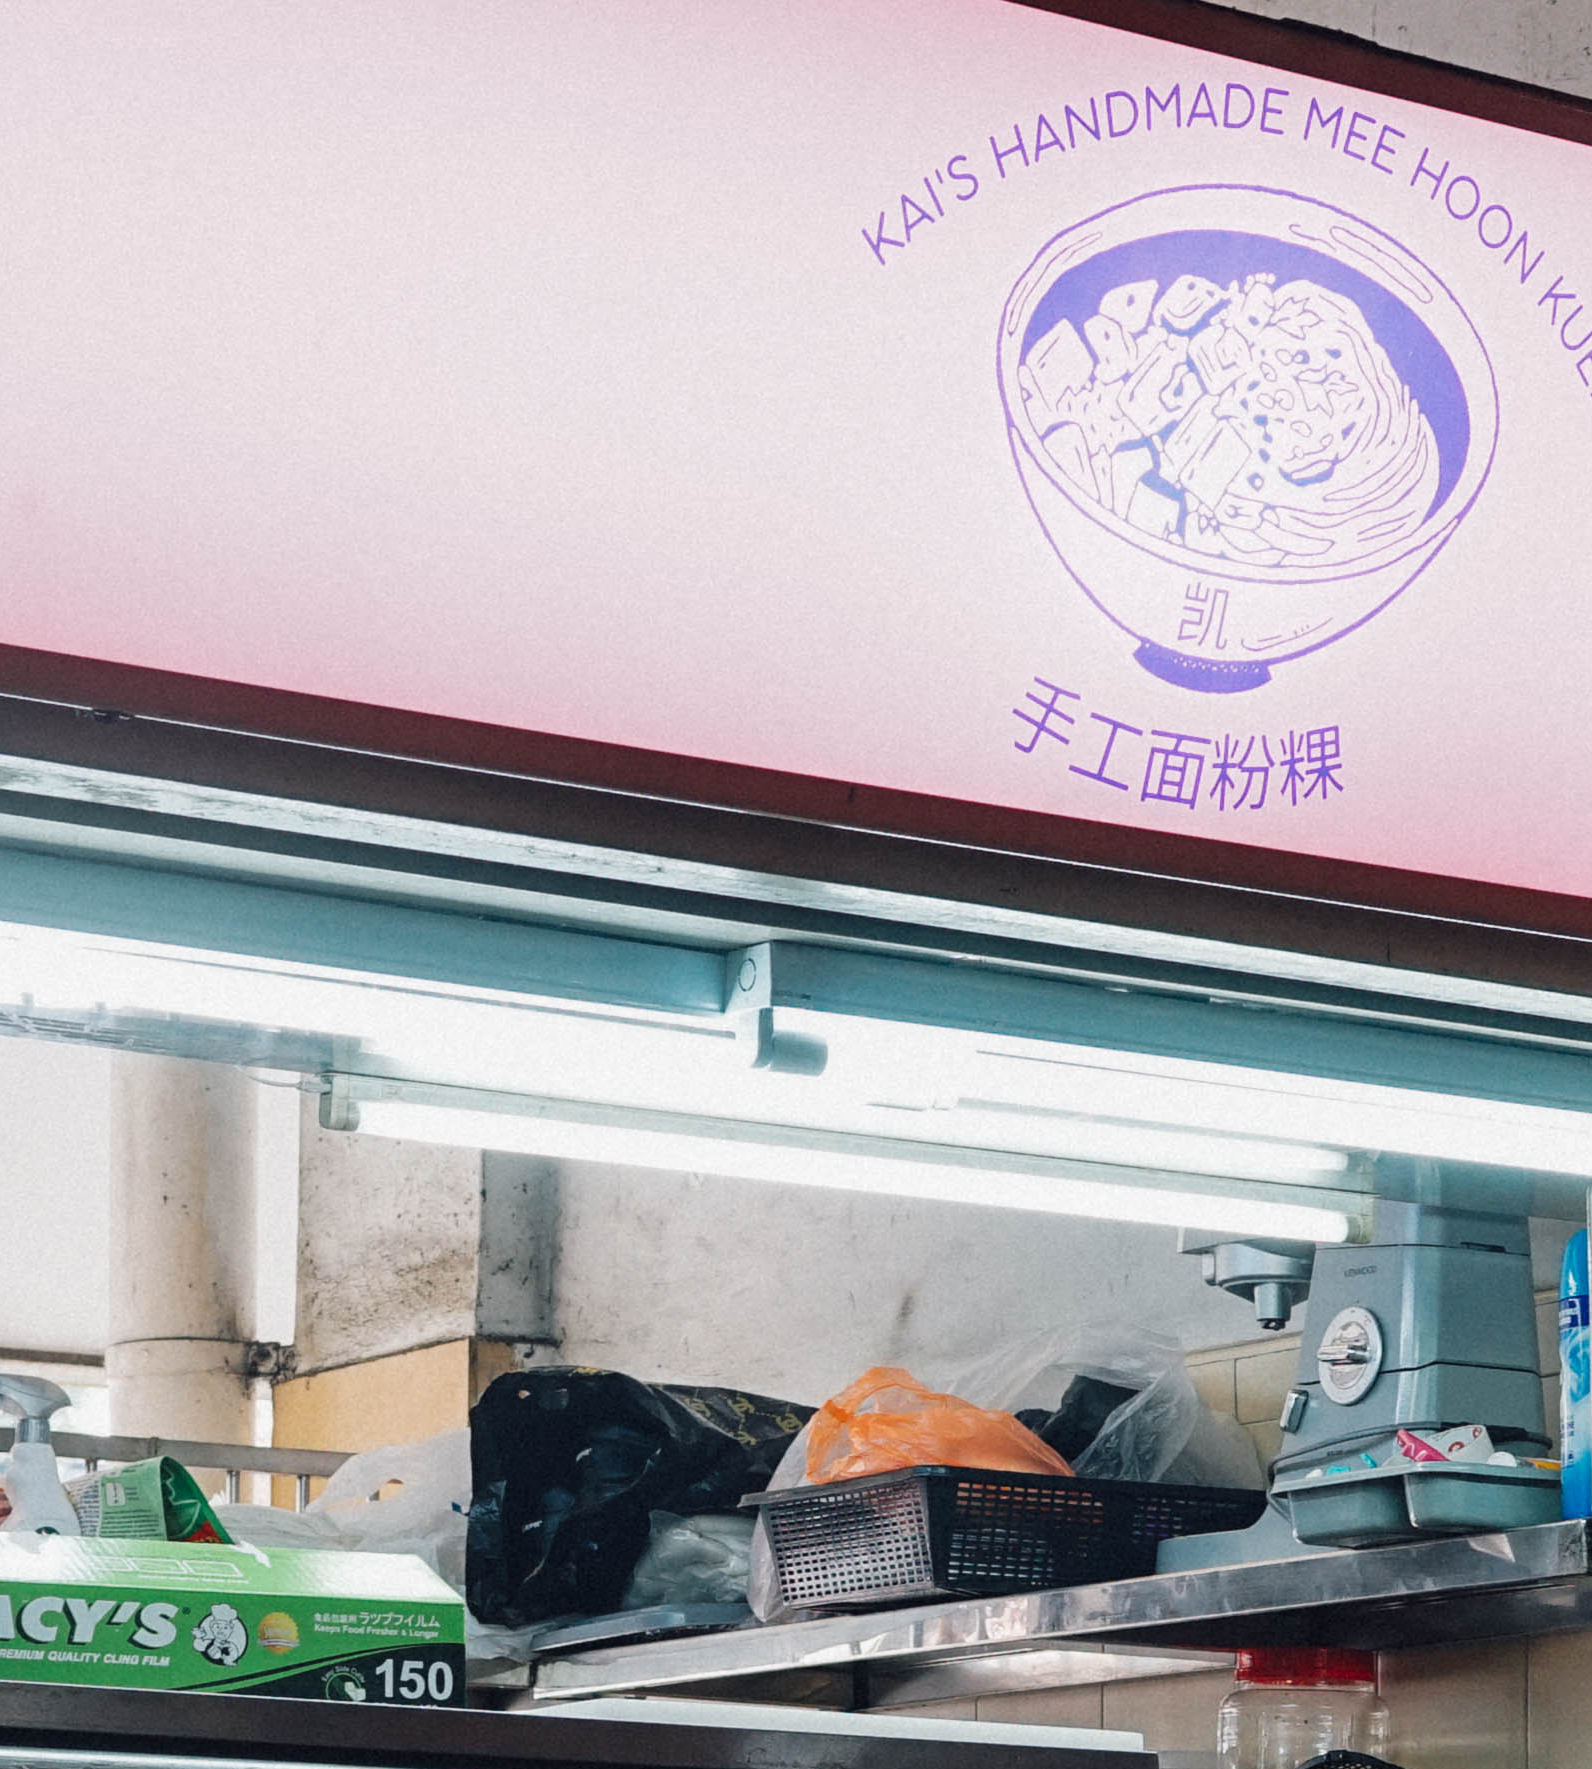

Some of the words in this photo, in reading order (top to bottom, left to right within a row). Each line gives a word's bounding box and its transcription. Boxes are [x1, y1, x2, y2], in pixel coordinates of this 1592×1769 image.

[861, 155, 980, 265] KAI'S
[989, 82, 1290, 180] HANDMADE
[1303, 97, 1407, 176] MEE
[1410, 147, 1545, 284] HOON
[1177, 582, 1232, 650] 凯
[1011, 676, 1345, 812] 手工面粉粿
[47, 1650, 99, 1663] QUALITY
[103, 1653, 140, 1666] CLING
[142, 1655, 171, 1668] FILM
[375, 1658, 454, 1701] 150
